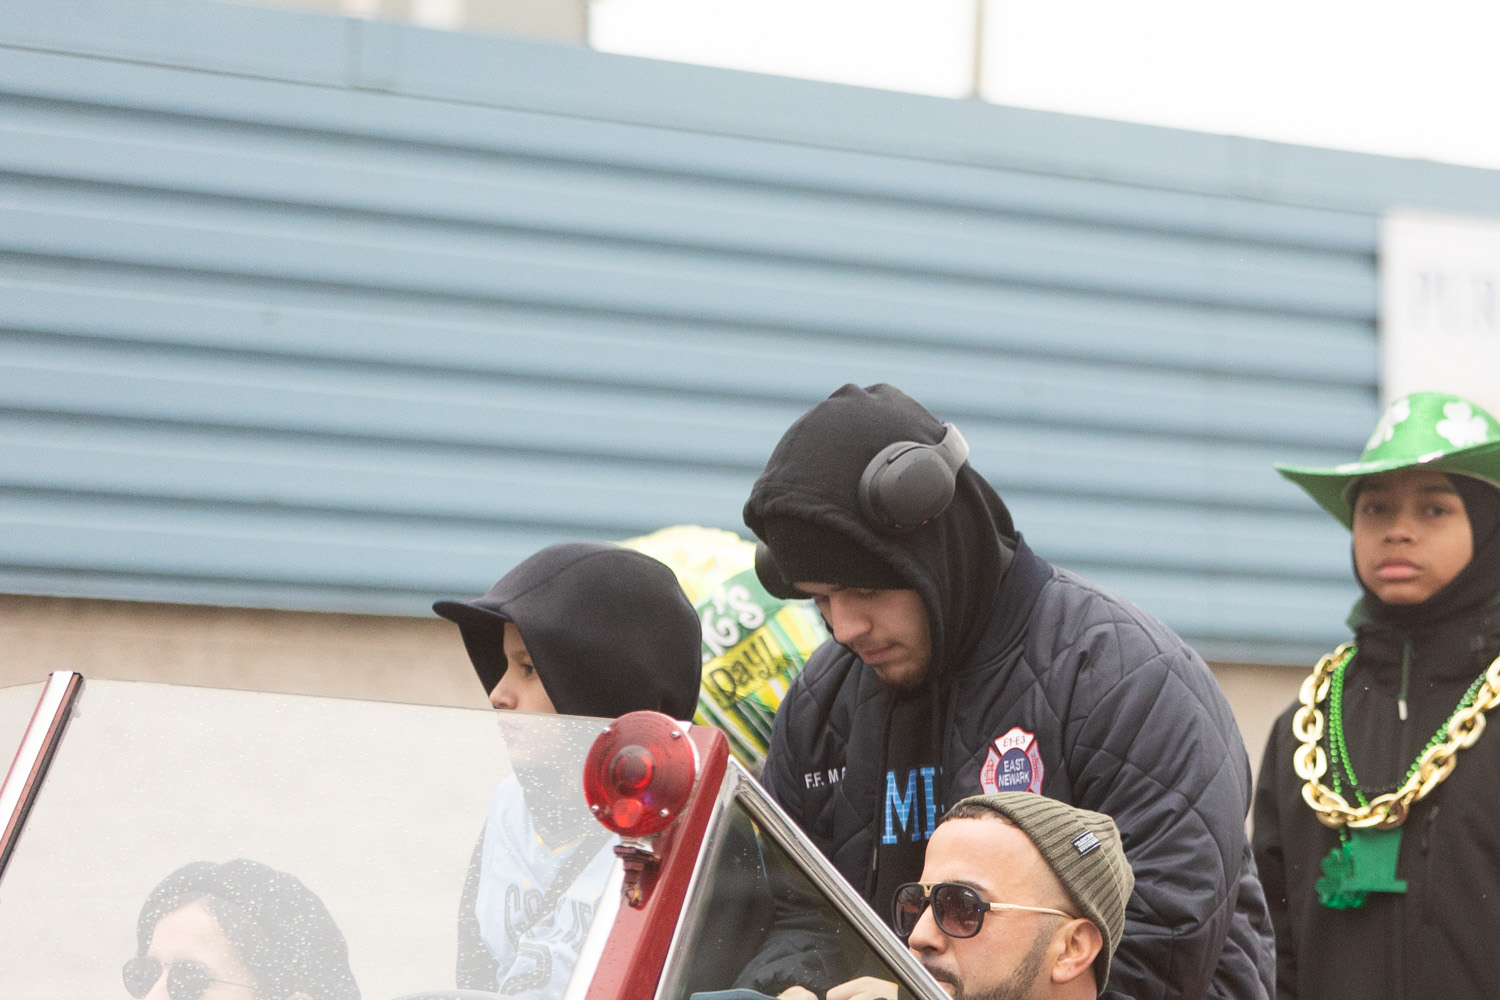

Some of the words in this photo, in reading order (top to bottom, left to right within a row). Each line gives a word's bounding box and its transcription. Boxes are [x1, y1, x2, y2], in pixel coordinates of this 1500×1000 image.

[1003, 757, 1025, 773] EAST
[804, 771, 825, 789] F.F.
[998, 770, 1030, 788] NEWARK
